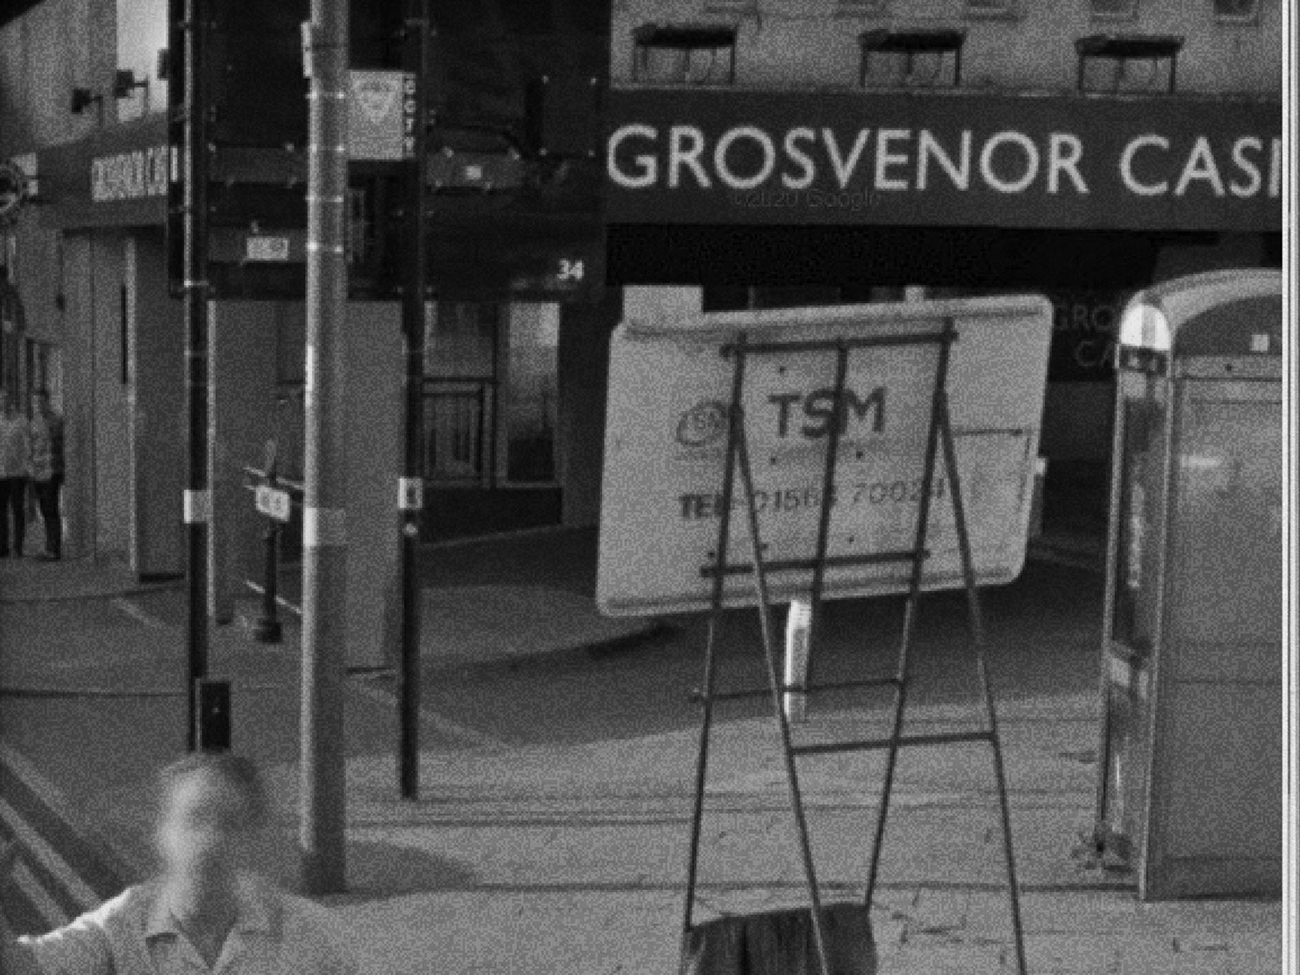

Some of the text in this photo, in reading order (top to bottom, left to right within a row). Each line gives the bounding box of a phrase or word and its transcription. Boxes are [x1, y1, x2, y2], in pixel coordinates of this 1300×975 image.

[607, 124, 1280, 198] GROSVENOR CASI
[557, 257, 584, 281] 34
[767, 386, 886, 439] TSM
